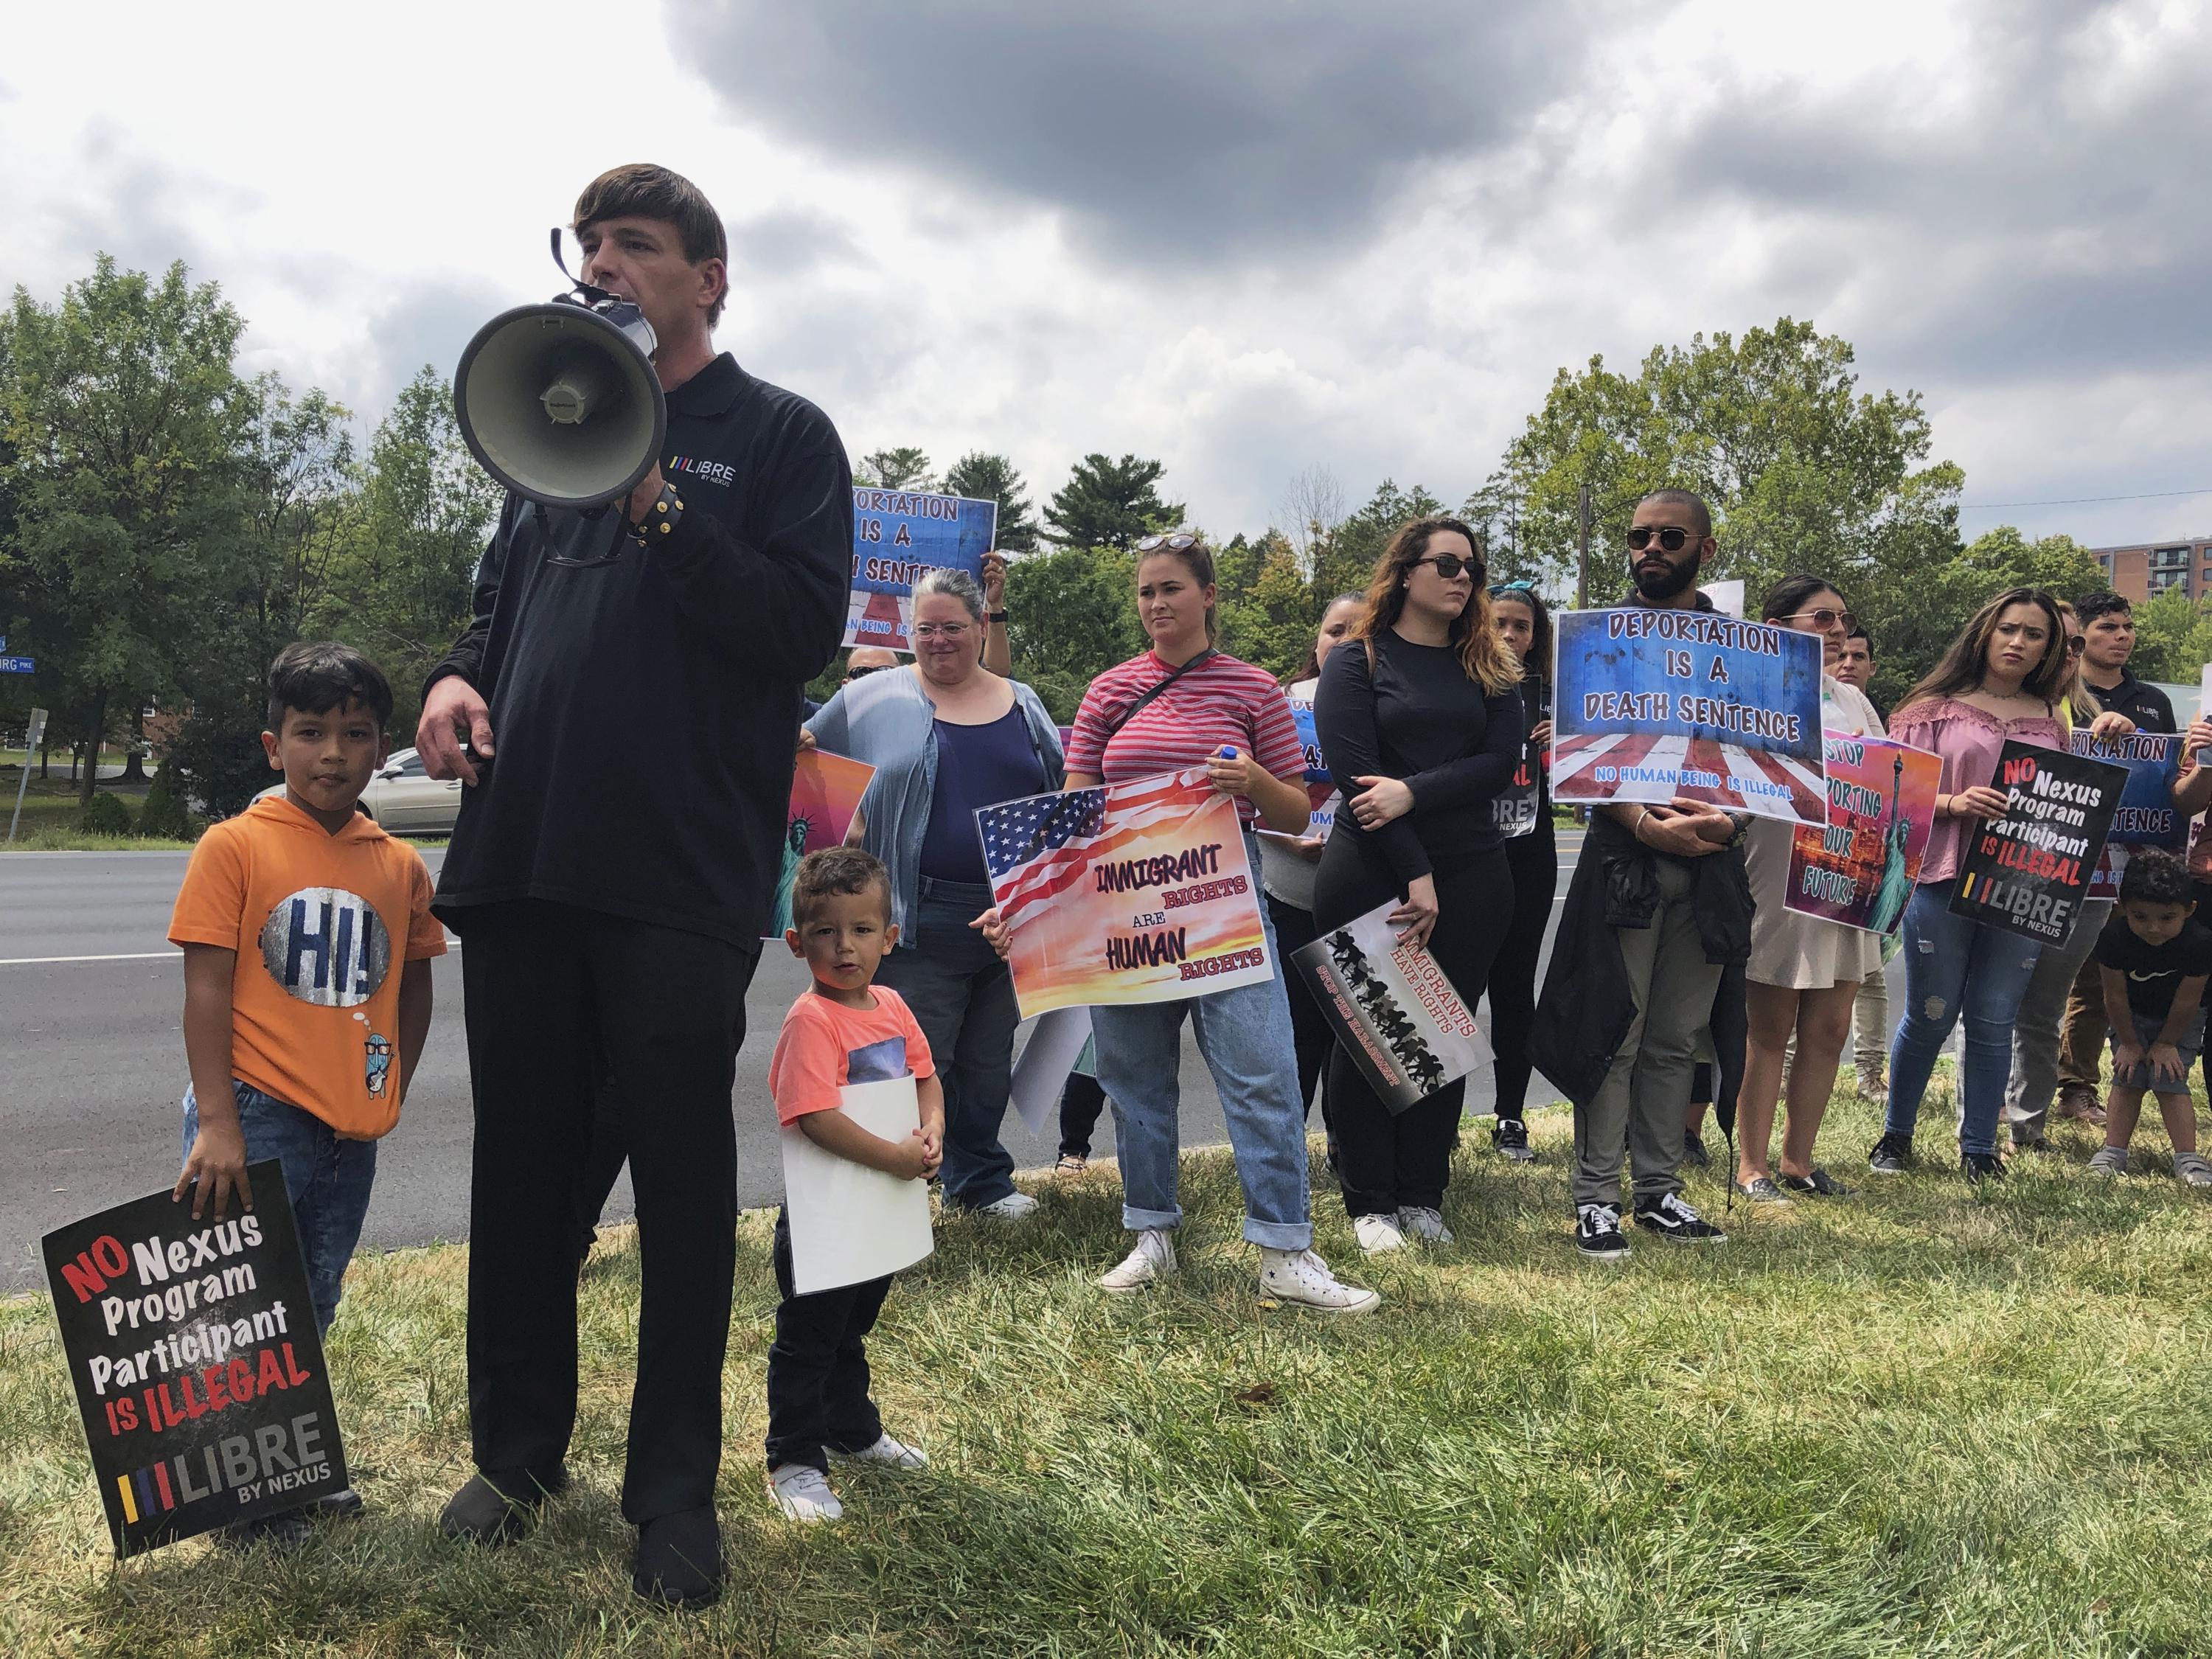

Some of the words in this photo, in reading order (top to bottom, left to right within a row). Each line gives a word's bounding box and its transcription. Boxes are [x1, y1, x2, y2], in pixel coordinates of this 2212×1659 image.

[686, 459, 736, 481] LIBRE
[710, 477, 731, 487] NEXUS
[852, 490, 959, 522] ORTATION
[860, 518, 882, 543] IS
[894, 523, 911, 548] A
[860, 619, 891, 634] BEING
[897, 624, 908, 636] IS
[1608, 611, 1781, 657] DEPORTATION
[1666, 649, 1692, 678] IS
[1708, 655, 1729, 684] A
[1585, 692, 1669, 721] DEATH
[1676, 695, 1800, 742] SENTENCE
[1825, 738, 1865, 768] STOP
[1595, 766, 1616, 782] NO
[1620, 767, 1676, 785] HUMAN
[1680, 770, 1720, 787] BEING
[1727, 776, 1742, 791] IS
[1744, 779, 1794, 801] ILLEGAL
[2004, 757, 2036, 785] NO
[2032, 770, 2101, 807] Nexus
[1499, 821, 1527, 831] NEXUS
[2006, 787, 2085, 827] Program
[2110, 807, 2172, 833] TENCE
[1824, 823, 1854, 858] OUR
[1985, 818, 2089, 857] Participant
[1094, 844, 1222, 894] IMMIGRANT
[1980, 835, 1997, 855] IS
[1997, 841, 2081, 886] ILLEGAL
[1161, 874, 1248, 910] RIGHTS
[1803, 866, 1858, 906] FUTURE
[1989, 880, 2071, 928] LIBRE
[1133, 911, 1165, 928] ARE
[2011, 915, 2027, 927] BY
[2027, 920, 2062, 938] NEXUS
[285, 898, 374, 995] HI!
[1106, 927, 1186, 971] HUMAN
[1178, 948, 1265, 981] RIGHTS
[1390, 947, 1419, 985] HAVE
[1413, 982, 1454, 1034] RIGHTS
[1395, 926, 1477, 1038] IMMIGRANTS
[1316, 964, 1338, 995] STOP
[1333, 993, 1354, 1020] THE
[1348, 1018, 1401, 1087] HARASSMENT
[60, 1235, 128, 1304] NO
[132, 1214, 262, 1286] Nexus
[102, 1264, 256, 1335] Program
[88, 1301, 288, 1395] Participant
[105, 1397, 139, 1435] IS
[143, 1343, 310, 1433] ILLEGAL
[174, 1411, 326, 1504] LIBRE
[239, 1484, 261, 1504] BY
[268, 1462, 331, 1495] NEXUS
